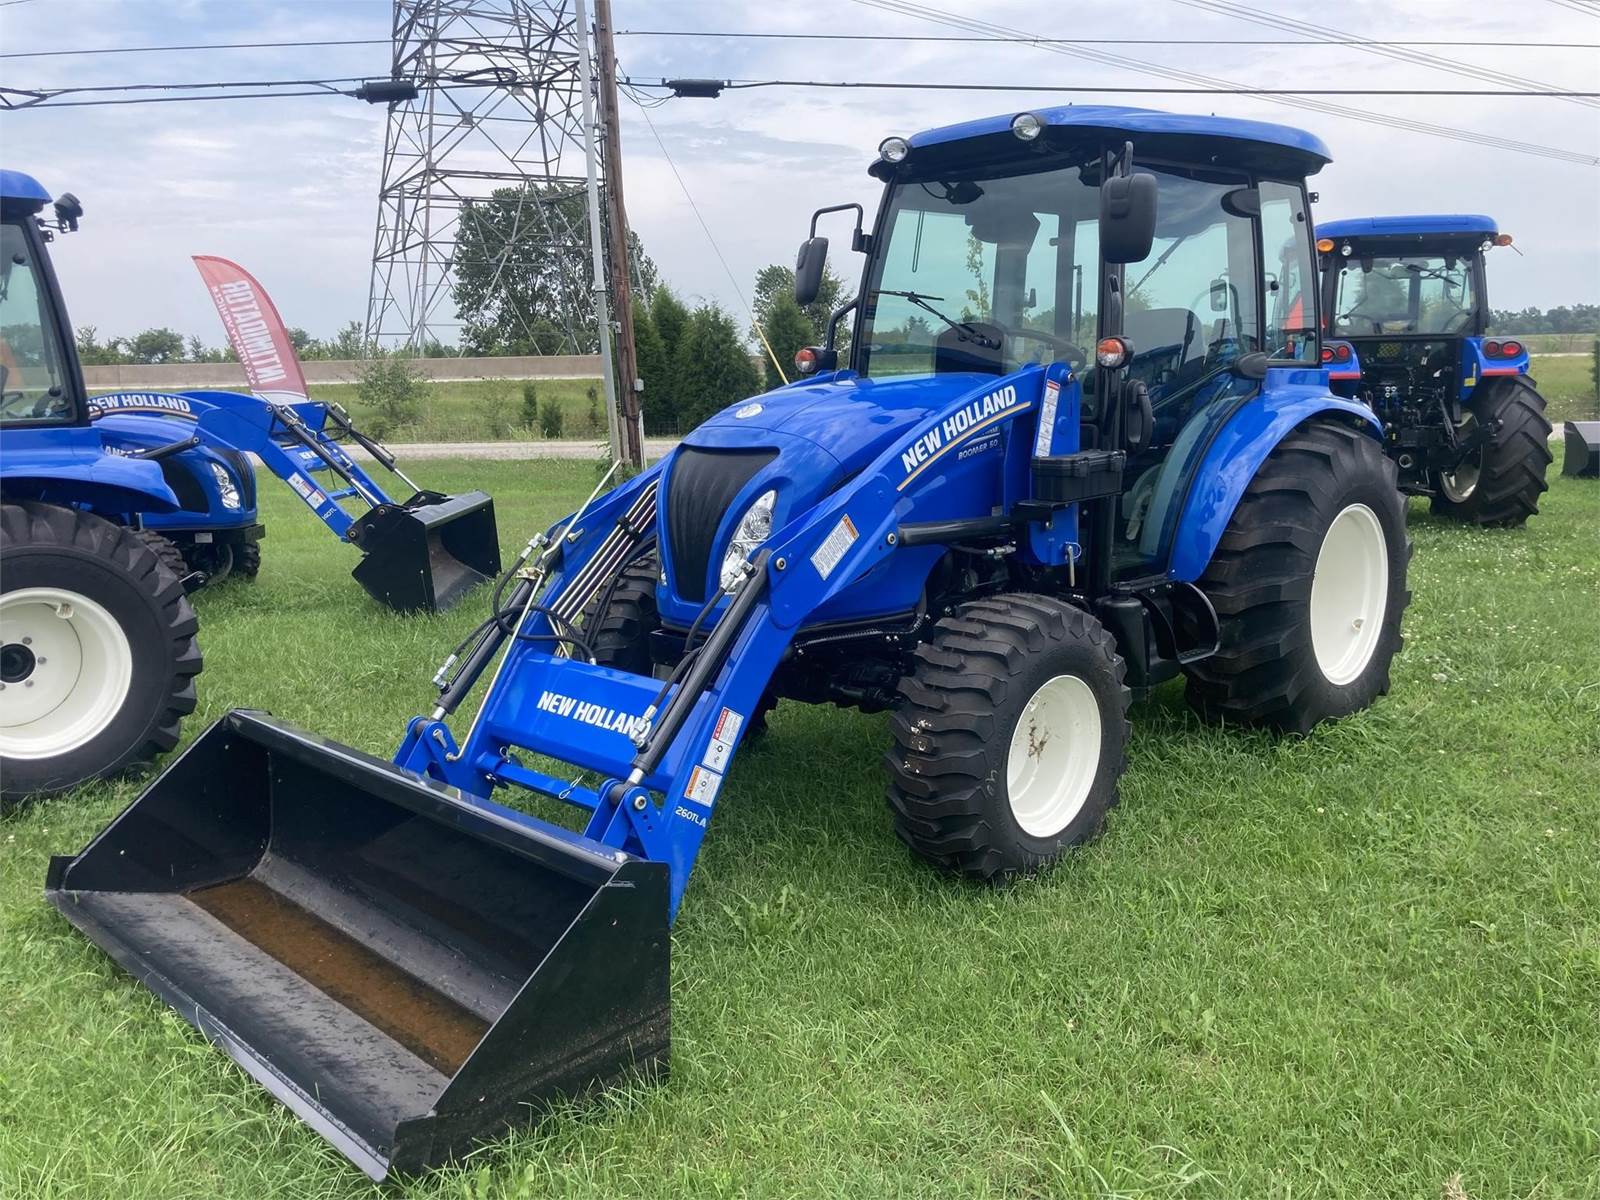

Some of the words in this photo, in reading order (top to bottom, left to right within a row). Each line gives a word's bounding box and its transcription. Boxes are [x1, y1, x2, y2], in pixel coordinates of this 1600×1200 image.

[120, 394, 191, 413] HOLLAND
[901, 426, 942, 473] NEW
[942, 384, 1016, 441] HOLLAND
[958, 442, 988, 460] BOOMER
[536, 690, 577, 717] NEW
[573, 701, 651, 739] HOLLAND
[675, 805, 707, 828] 260TLA
